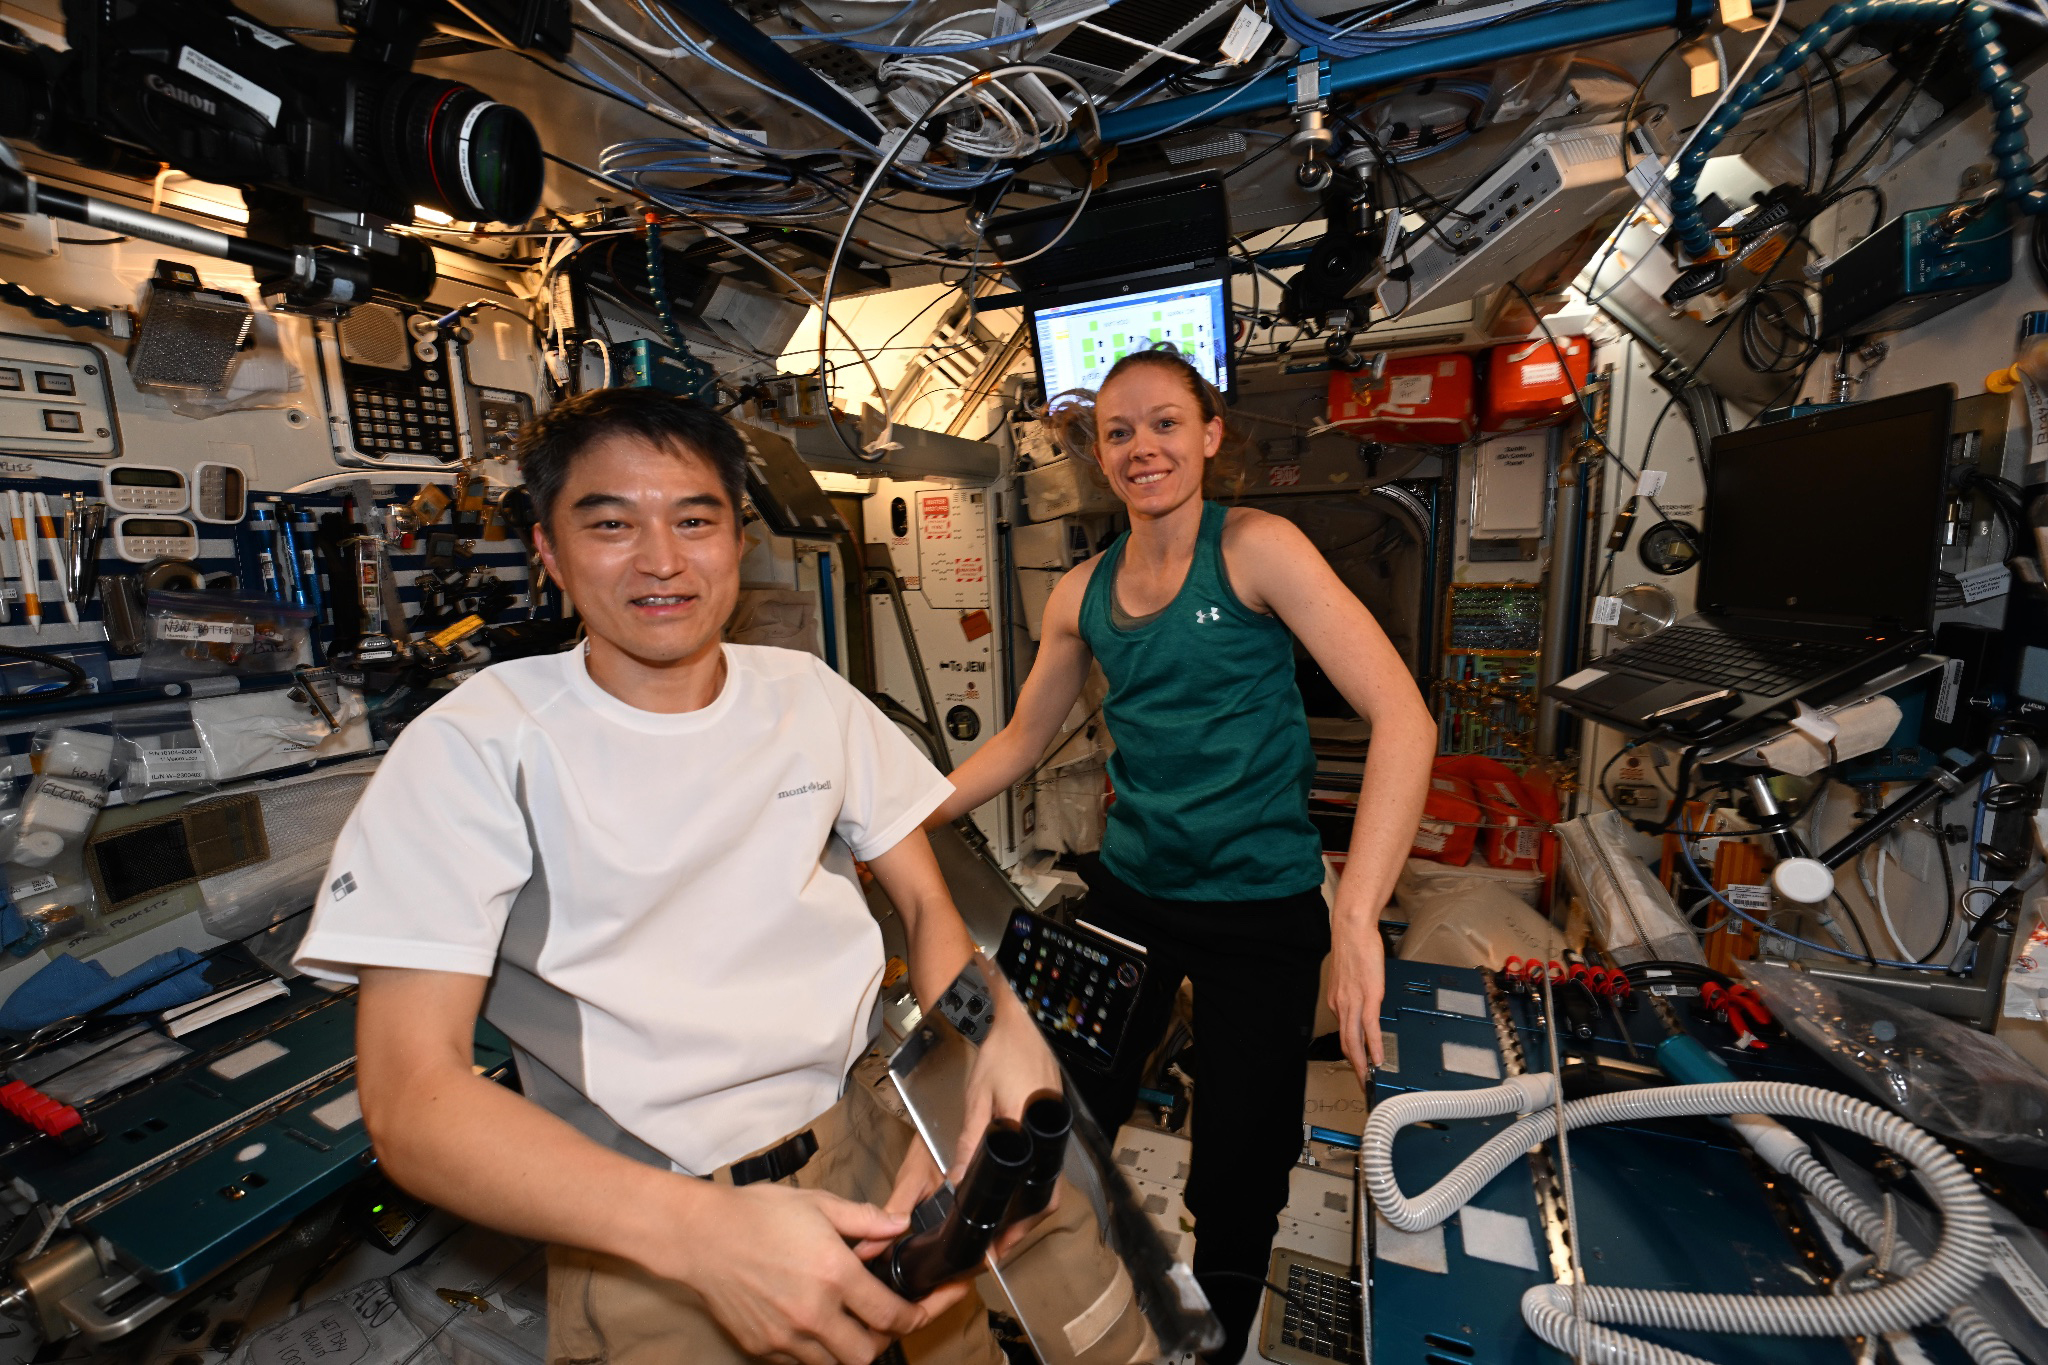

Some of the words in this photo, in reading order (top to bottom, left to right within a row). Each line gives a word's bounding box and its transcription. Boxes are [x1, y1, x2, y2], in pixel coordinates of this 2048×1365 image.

[146, 73, 217, 116] Canon
[1274, 468, 1296, 482] EXIT
[199, 625, 251, 637] BATTERIES
[949, 660, 962, 672] To
[964, 661, 987, 673] JEM
[778, 784, 808, 799] mont
[816, 780, 832, 791] bell
[110, 899, 169, 929] POCKETS
